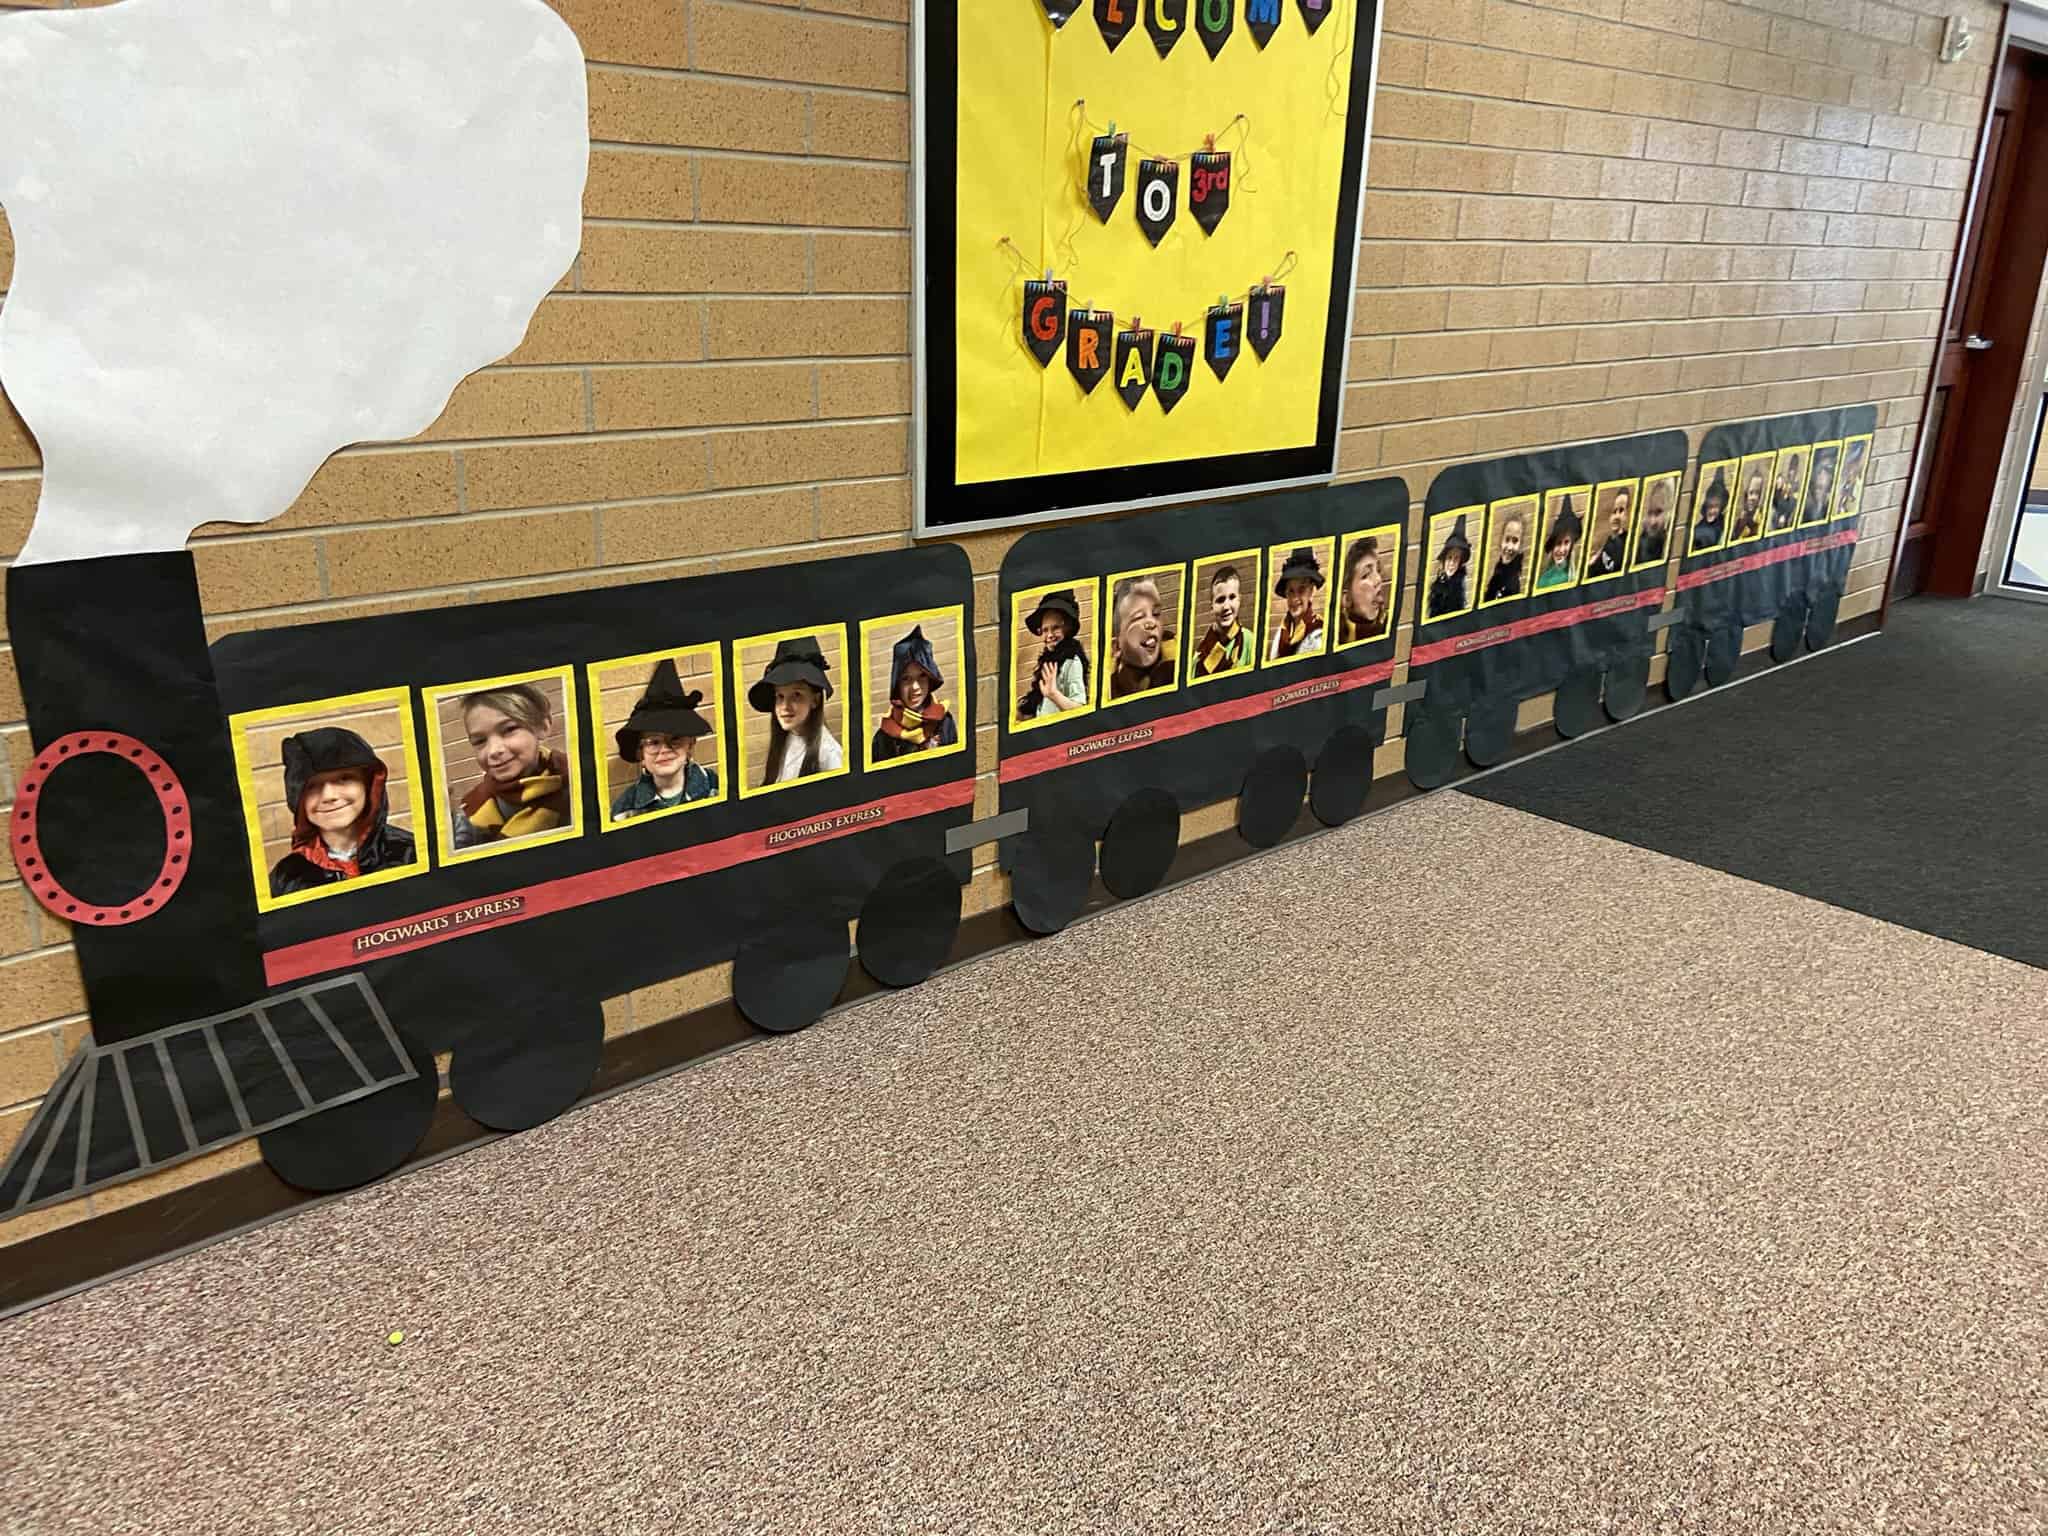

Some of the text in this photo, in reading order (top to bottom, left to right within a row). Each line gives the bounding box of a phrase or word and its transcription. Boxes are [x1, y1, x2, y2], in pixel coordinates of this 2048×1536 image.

[1100, 152, 1228, 221] TO 3rd
[1031, 296, 1270, 390] GRADE!
[1068, 728, 1153, 756] HOGWARTS EXPRESS
[769, 806, 881, 843] HOGWARTS EXPRESS
[356, 897, 520, 950] HOGWARTS EXPRESS
